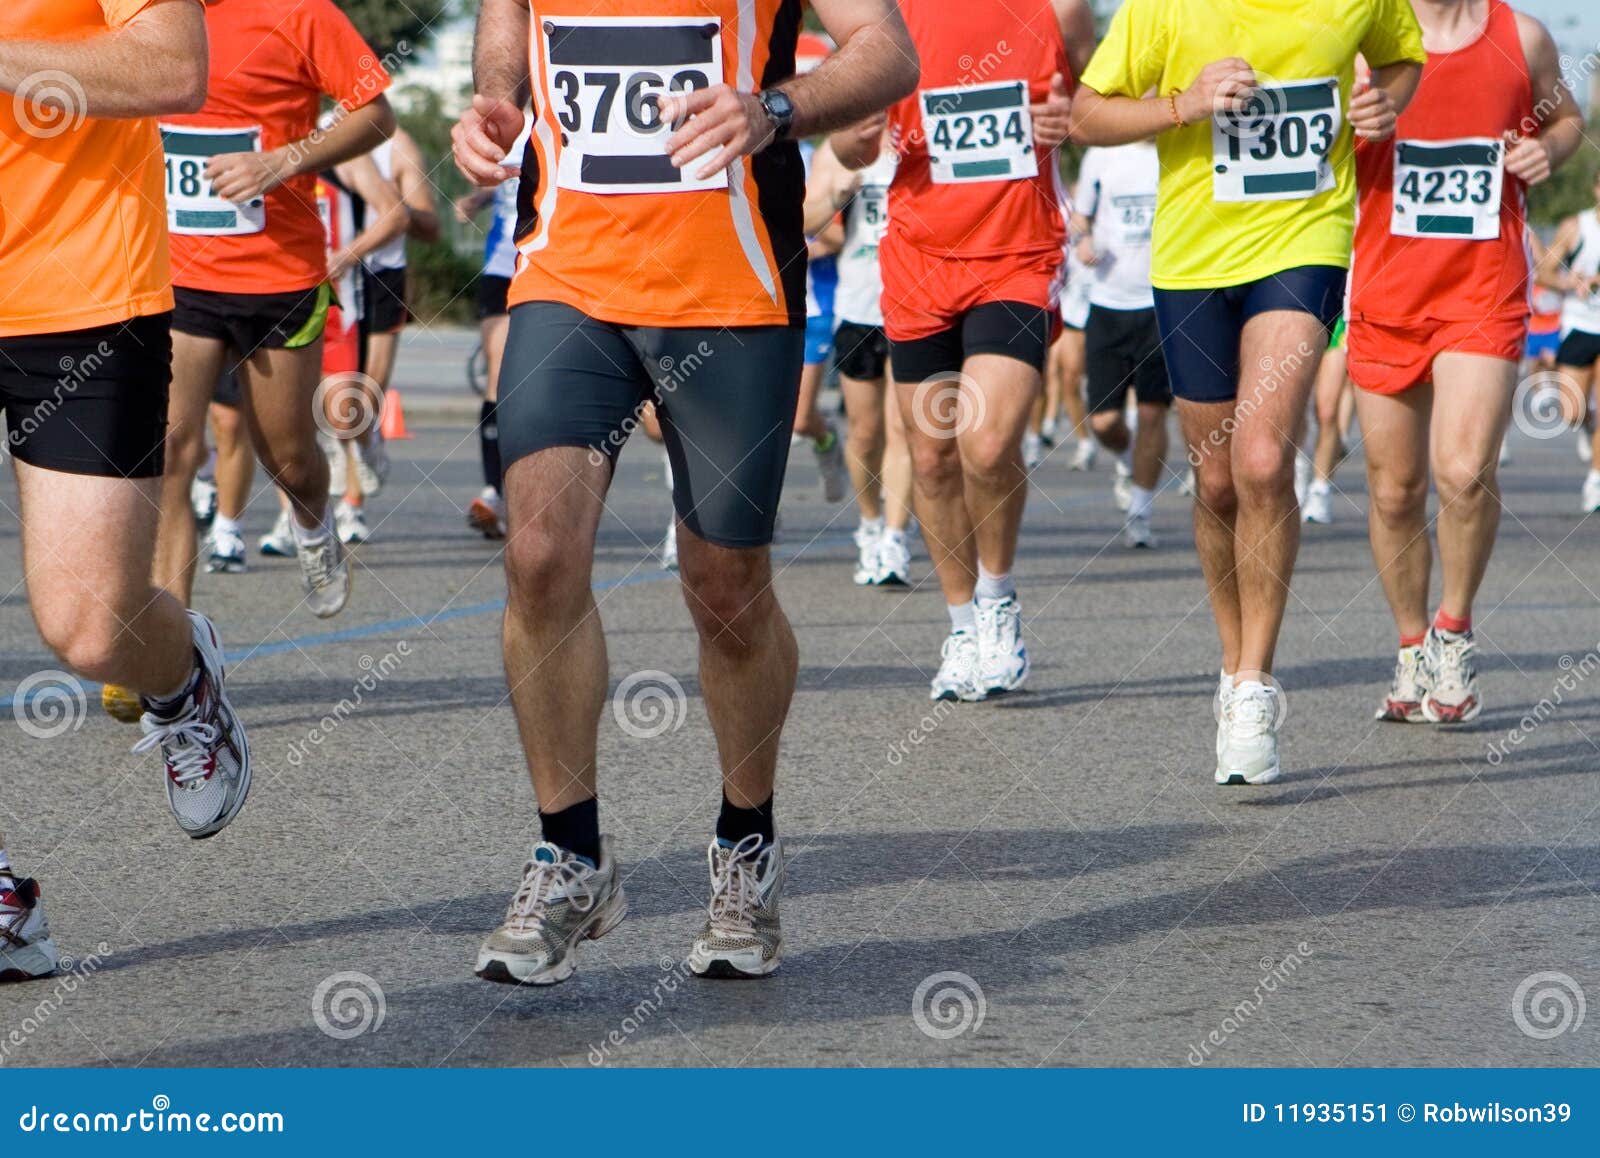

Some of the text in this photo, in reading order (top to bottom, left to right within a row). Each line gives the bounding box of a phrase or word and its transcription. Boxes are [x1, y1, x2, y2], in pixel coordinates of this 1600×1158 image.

[933, 111, 1025, 152] 4234
[1221, 113, 1334, 162] 1303
[1400, 169, 1492, 205] 4233
